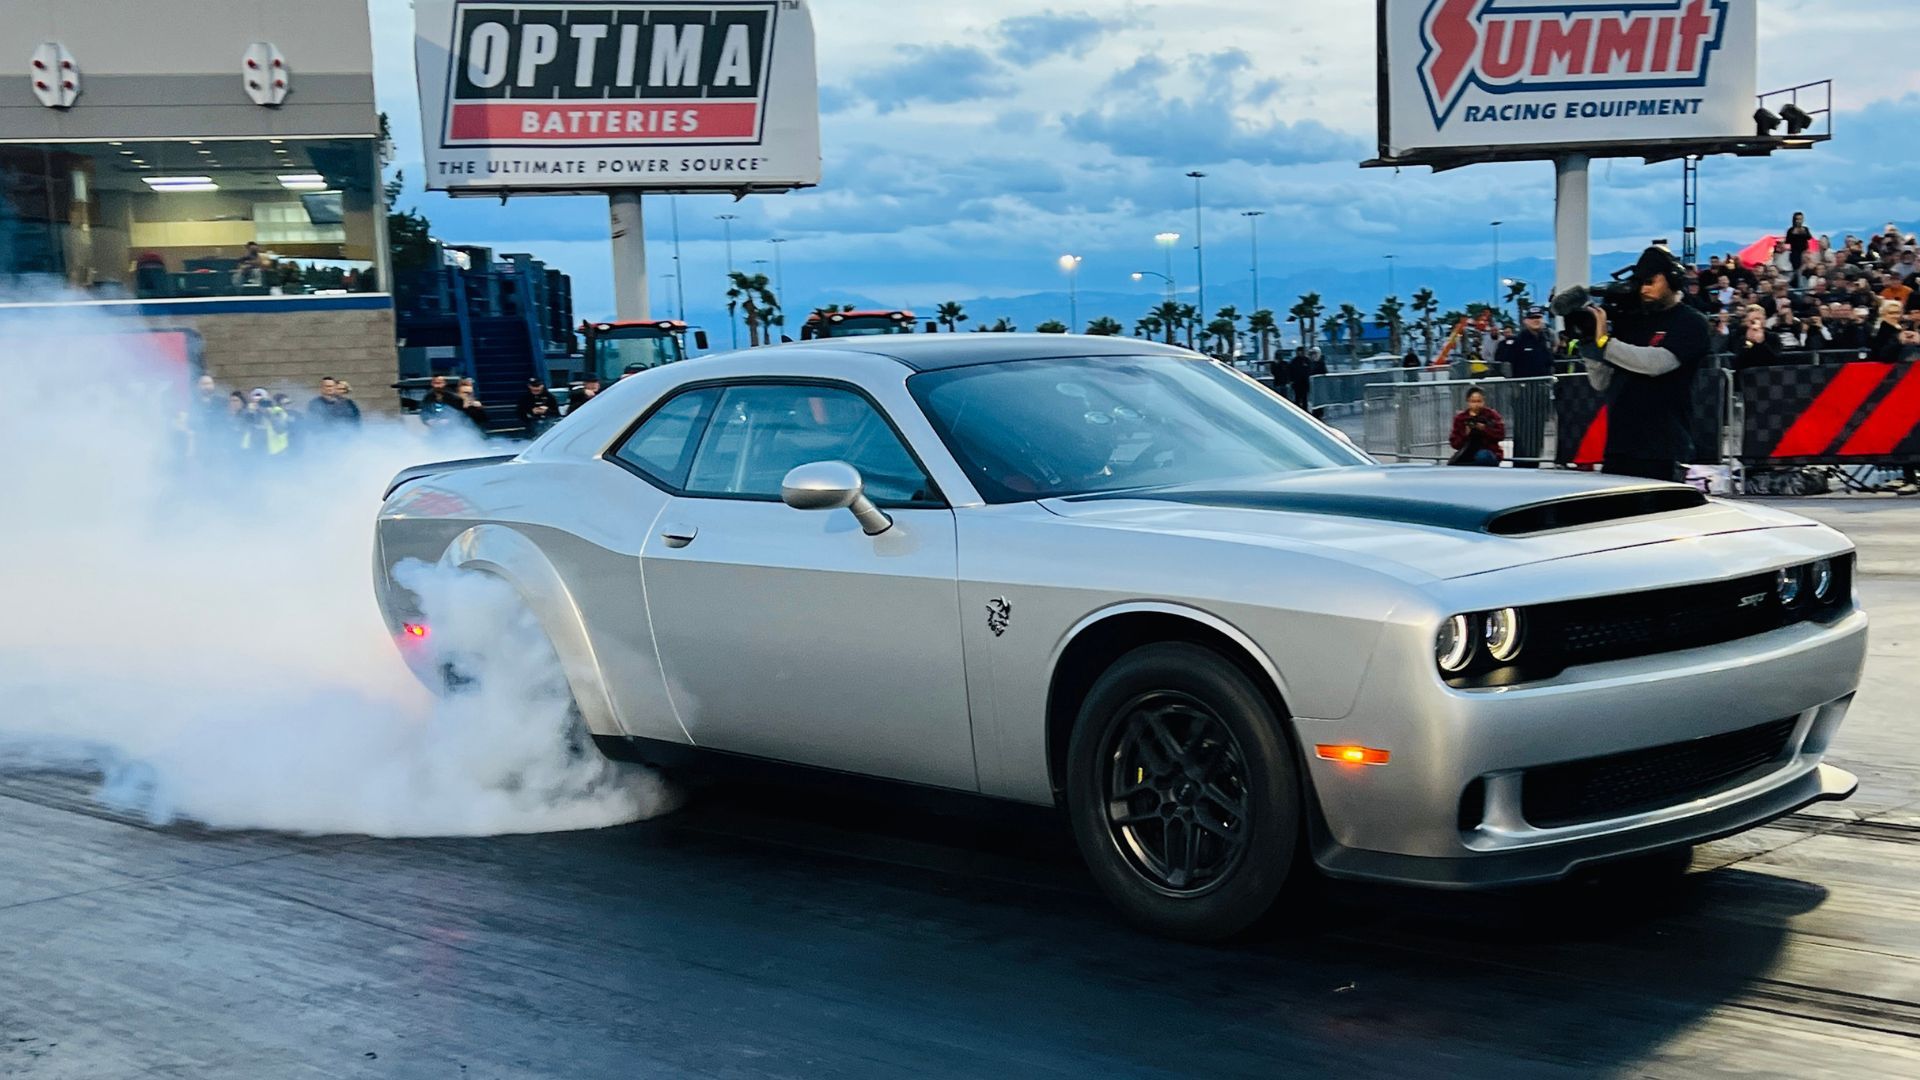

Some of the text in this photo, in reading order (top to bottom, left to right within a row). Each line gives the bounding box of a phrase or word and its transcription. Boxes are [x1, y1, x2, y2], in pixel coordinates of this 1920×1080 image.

[466, 21, 753, 89] OPTIMA
[521, 109, 699, 134] BATTERIES
[1464, 98, 1703, 122] RACING EQUIPMENT
[438, 160, 475, 175] THE
[487, 160, 585, 174] ULTIMATE
[597, 158, 669, 173] POWER
[1738, 592, 1767, 606] SRT
